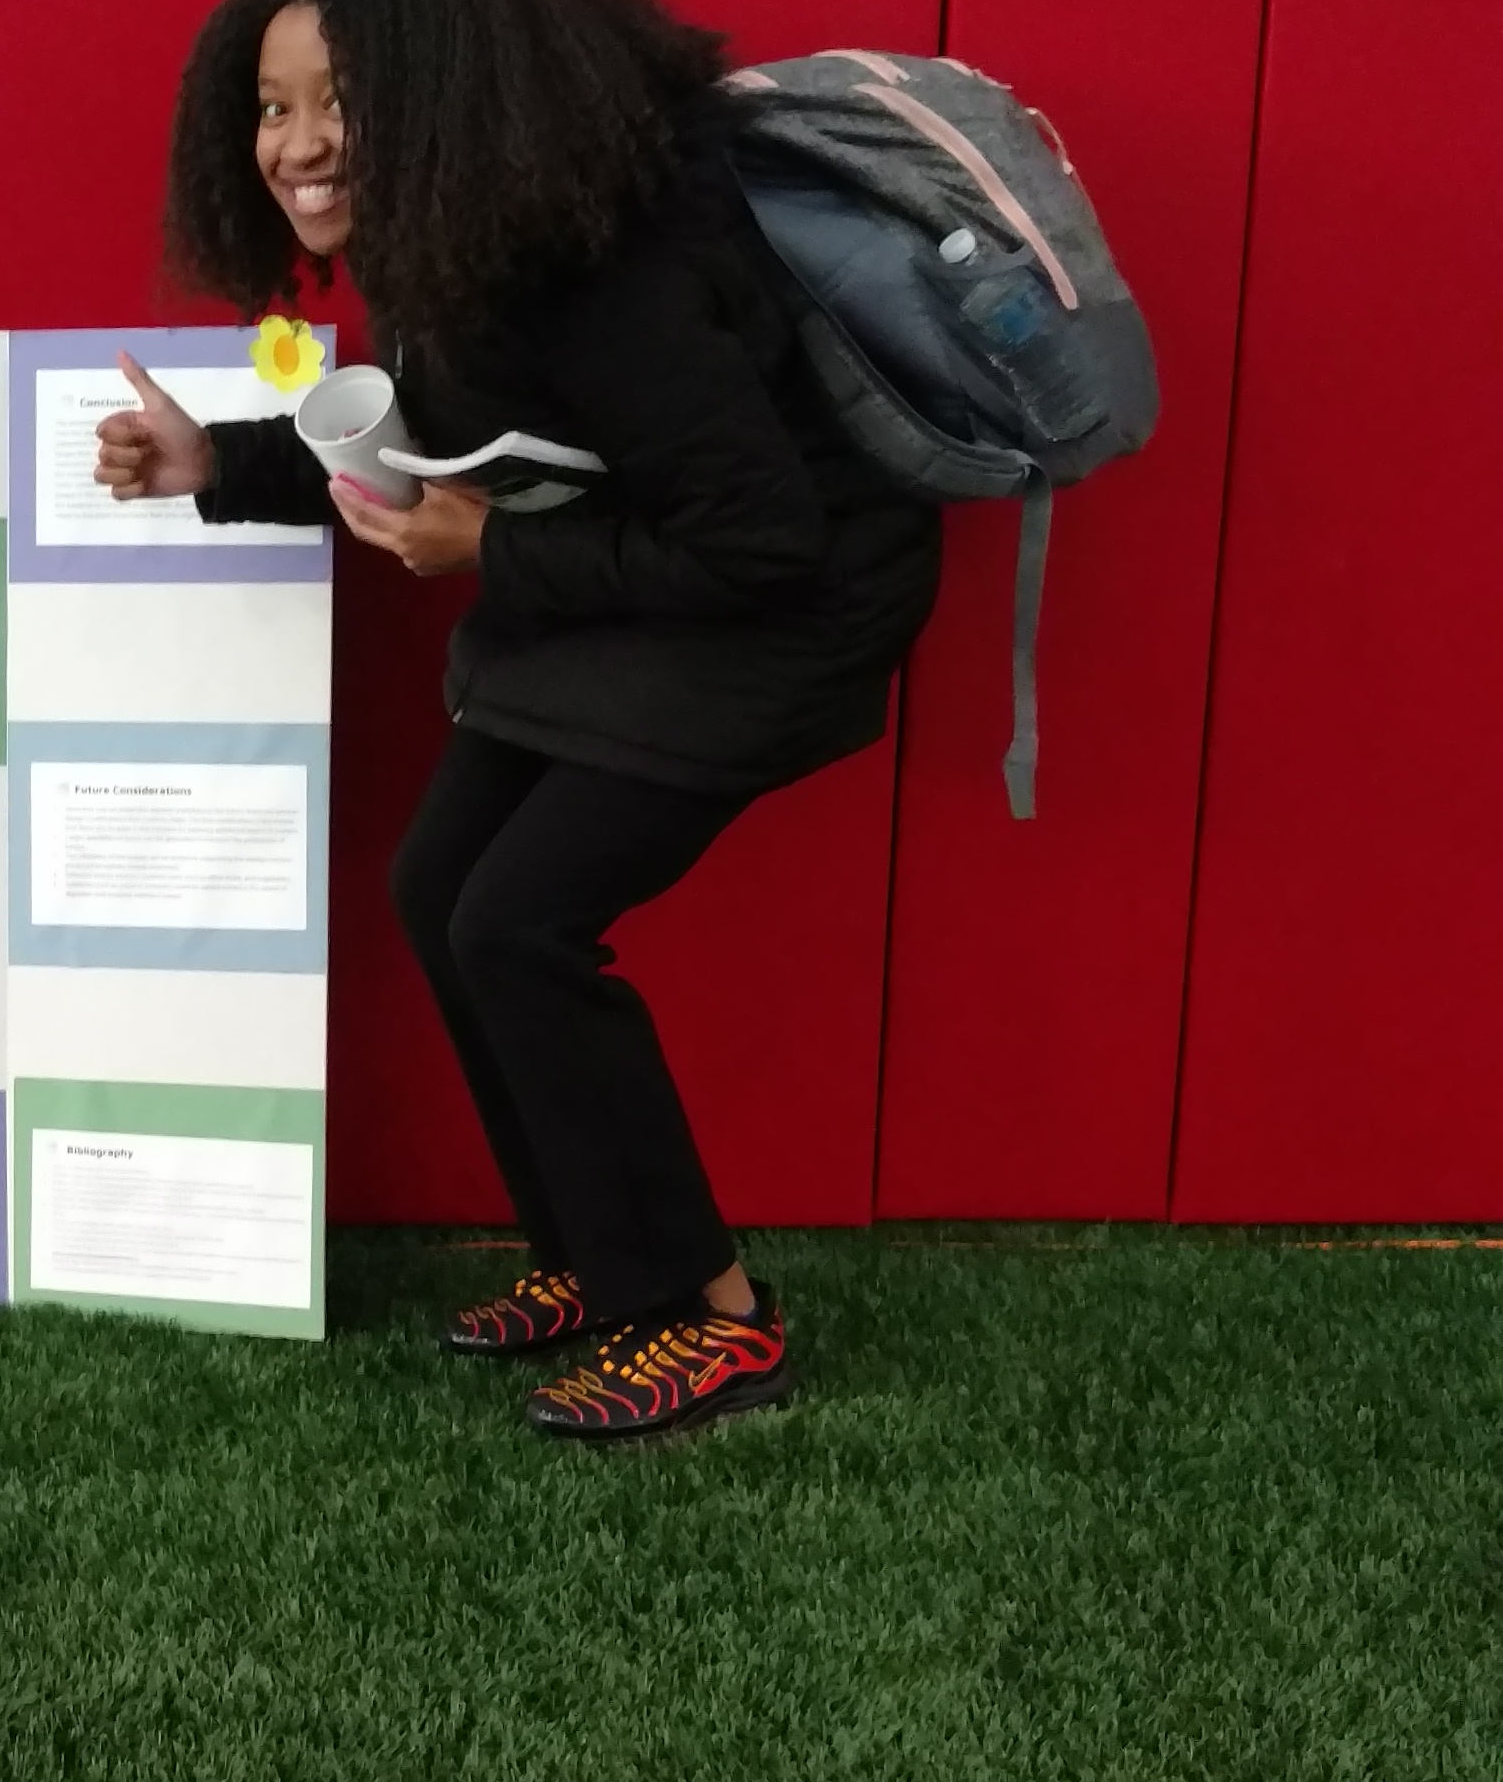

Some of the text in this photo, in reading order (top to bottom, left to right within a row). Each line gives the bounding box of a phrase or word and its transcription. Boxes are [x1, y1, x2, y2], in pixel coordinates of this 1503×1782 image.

[80, 397, 138, 408] Conclusion
[74, 785, 192, 796] Future Considerations
[66, 1145, 134, 1160] Bibliography
